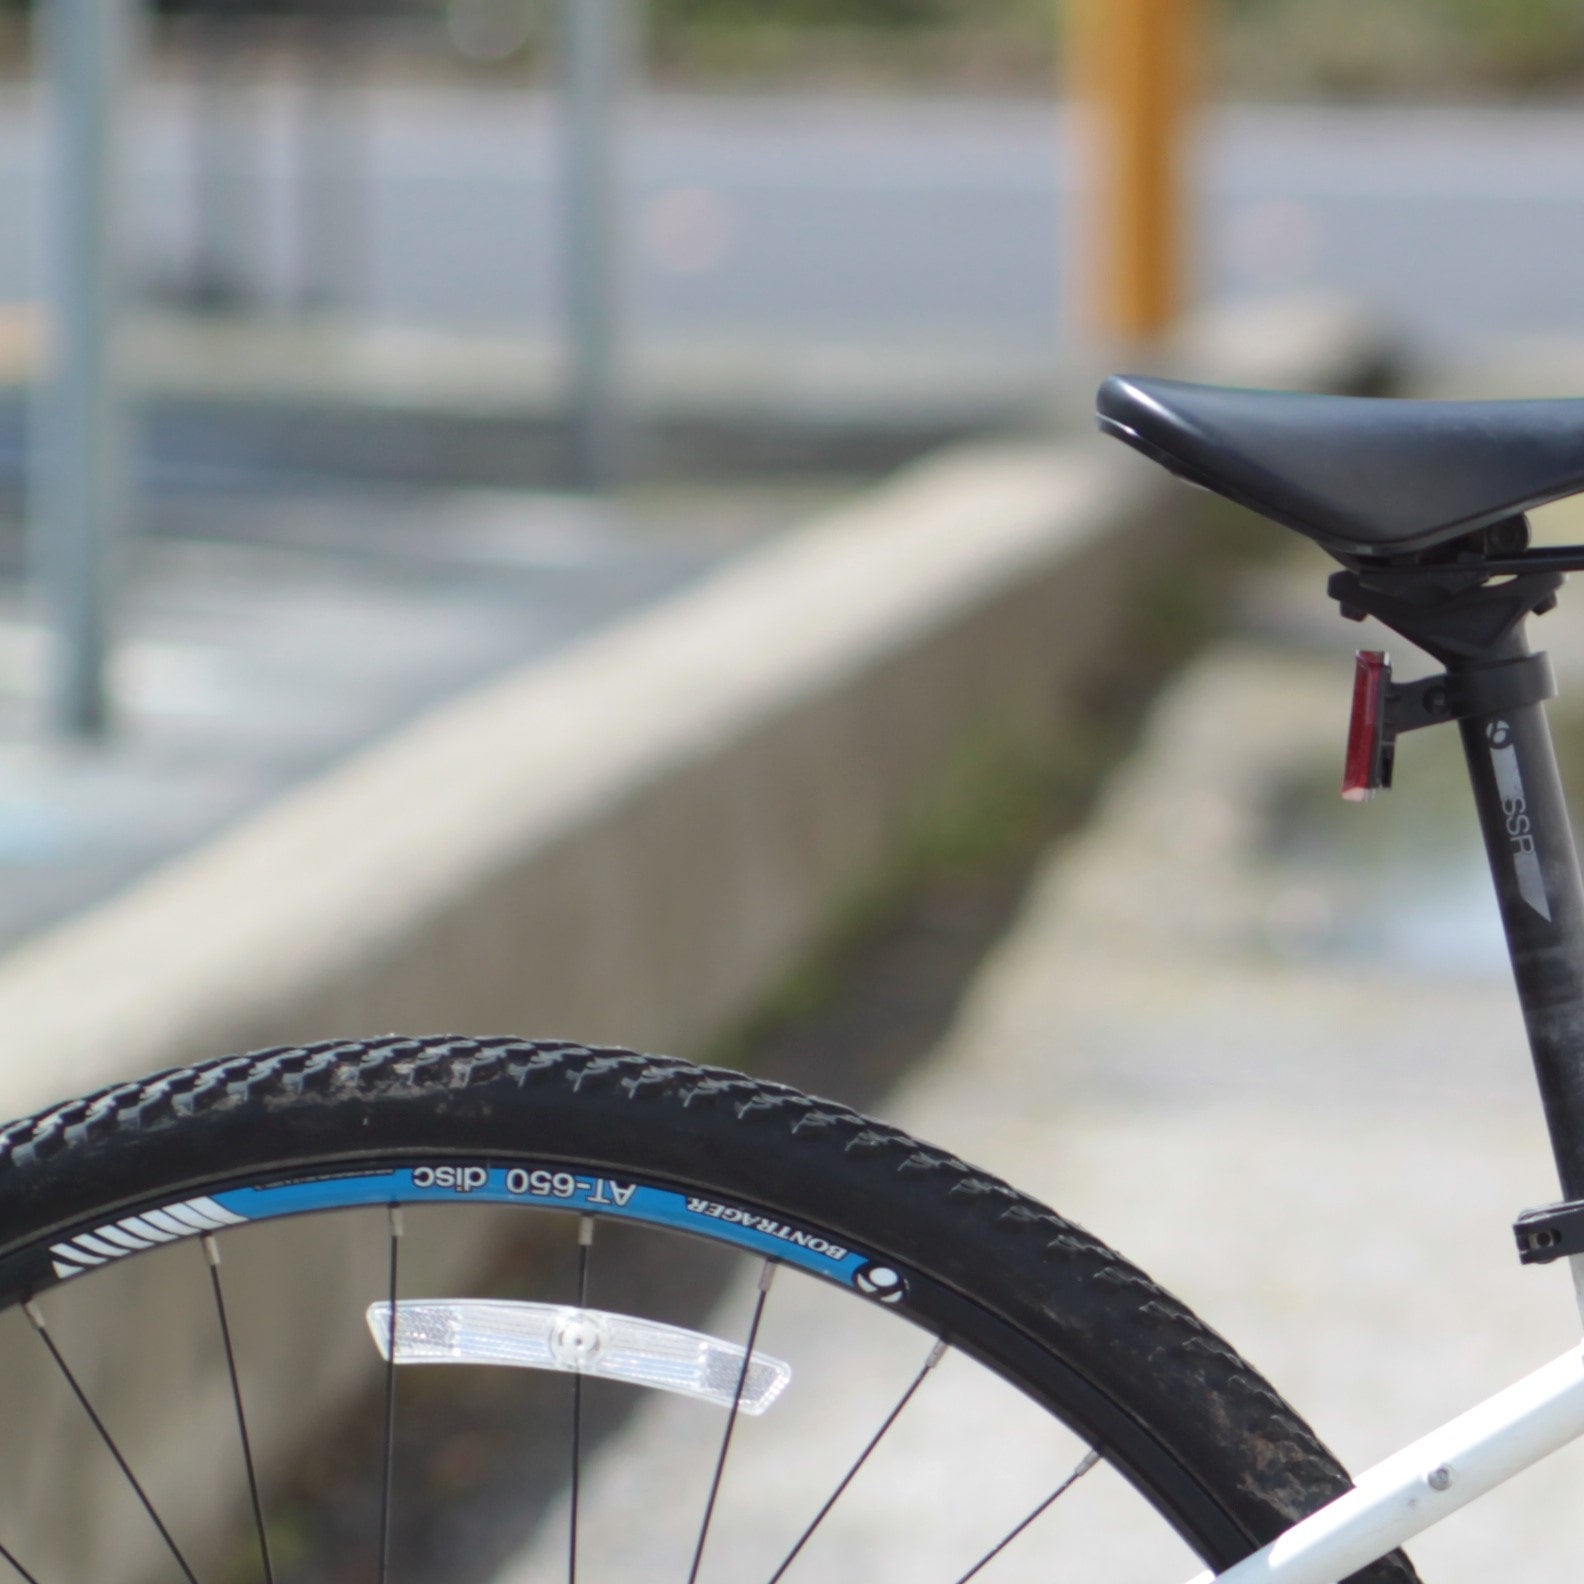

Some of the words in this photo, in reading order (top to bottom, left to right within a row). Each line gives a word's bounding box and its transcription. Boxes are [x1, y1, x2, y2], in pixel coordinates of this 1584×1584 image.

[1502, 797, 1535, 855] SSR
[412, 1166, 488, 1193] disc
[506, 1168, 637, 1207] AT-650
[687, 1197, 848, 1261] BONTRAGER
